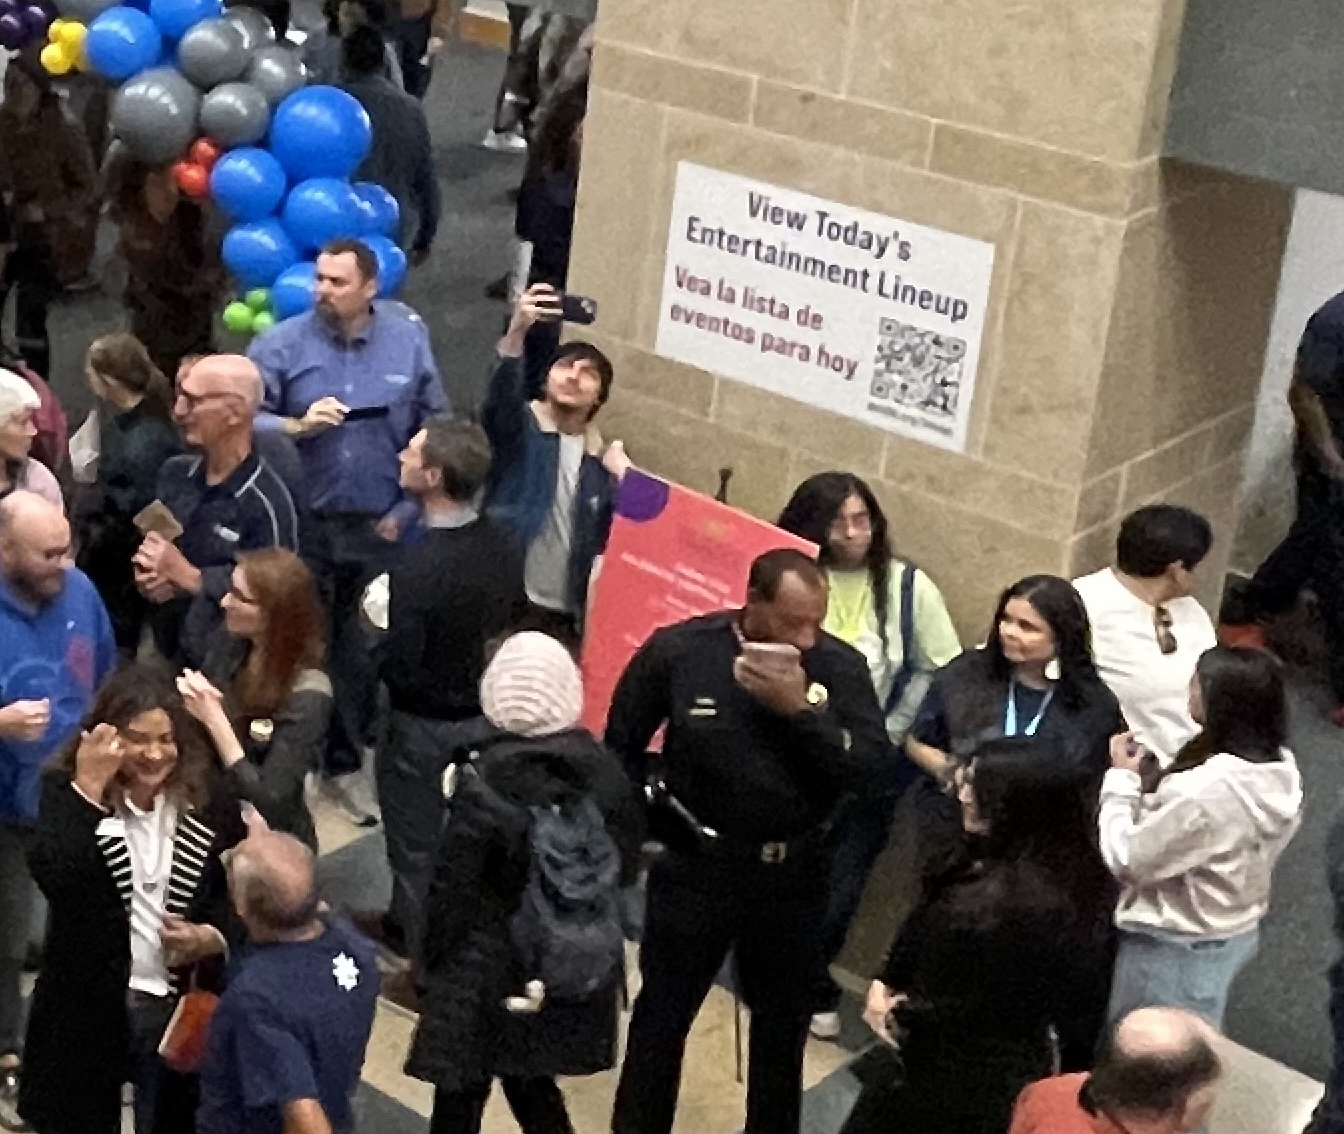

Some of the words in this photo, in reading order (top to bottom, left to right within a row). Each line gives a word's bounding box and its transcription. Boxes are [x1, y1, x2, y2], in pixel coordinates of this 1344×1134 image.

[748, 191, 807, 232] View
[815, 210, 911, 261] Today's
[674, 265, 712, 297] Vea
[716, 277, 737, 305] la
[742, 285, 790, 320] lista
[796, 304, 824, 330] de
[687, 215, 869, 293] Entertainment
[877, 270, 968, 323] Lineup
[670, 302, 755, 345] eventos
[760, 331, 811, 363] para
[816, 344, 859, 381] hoy
